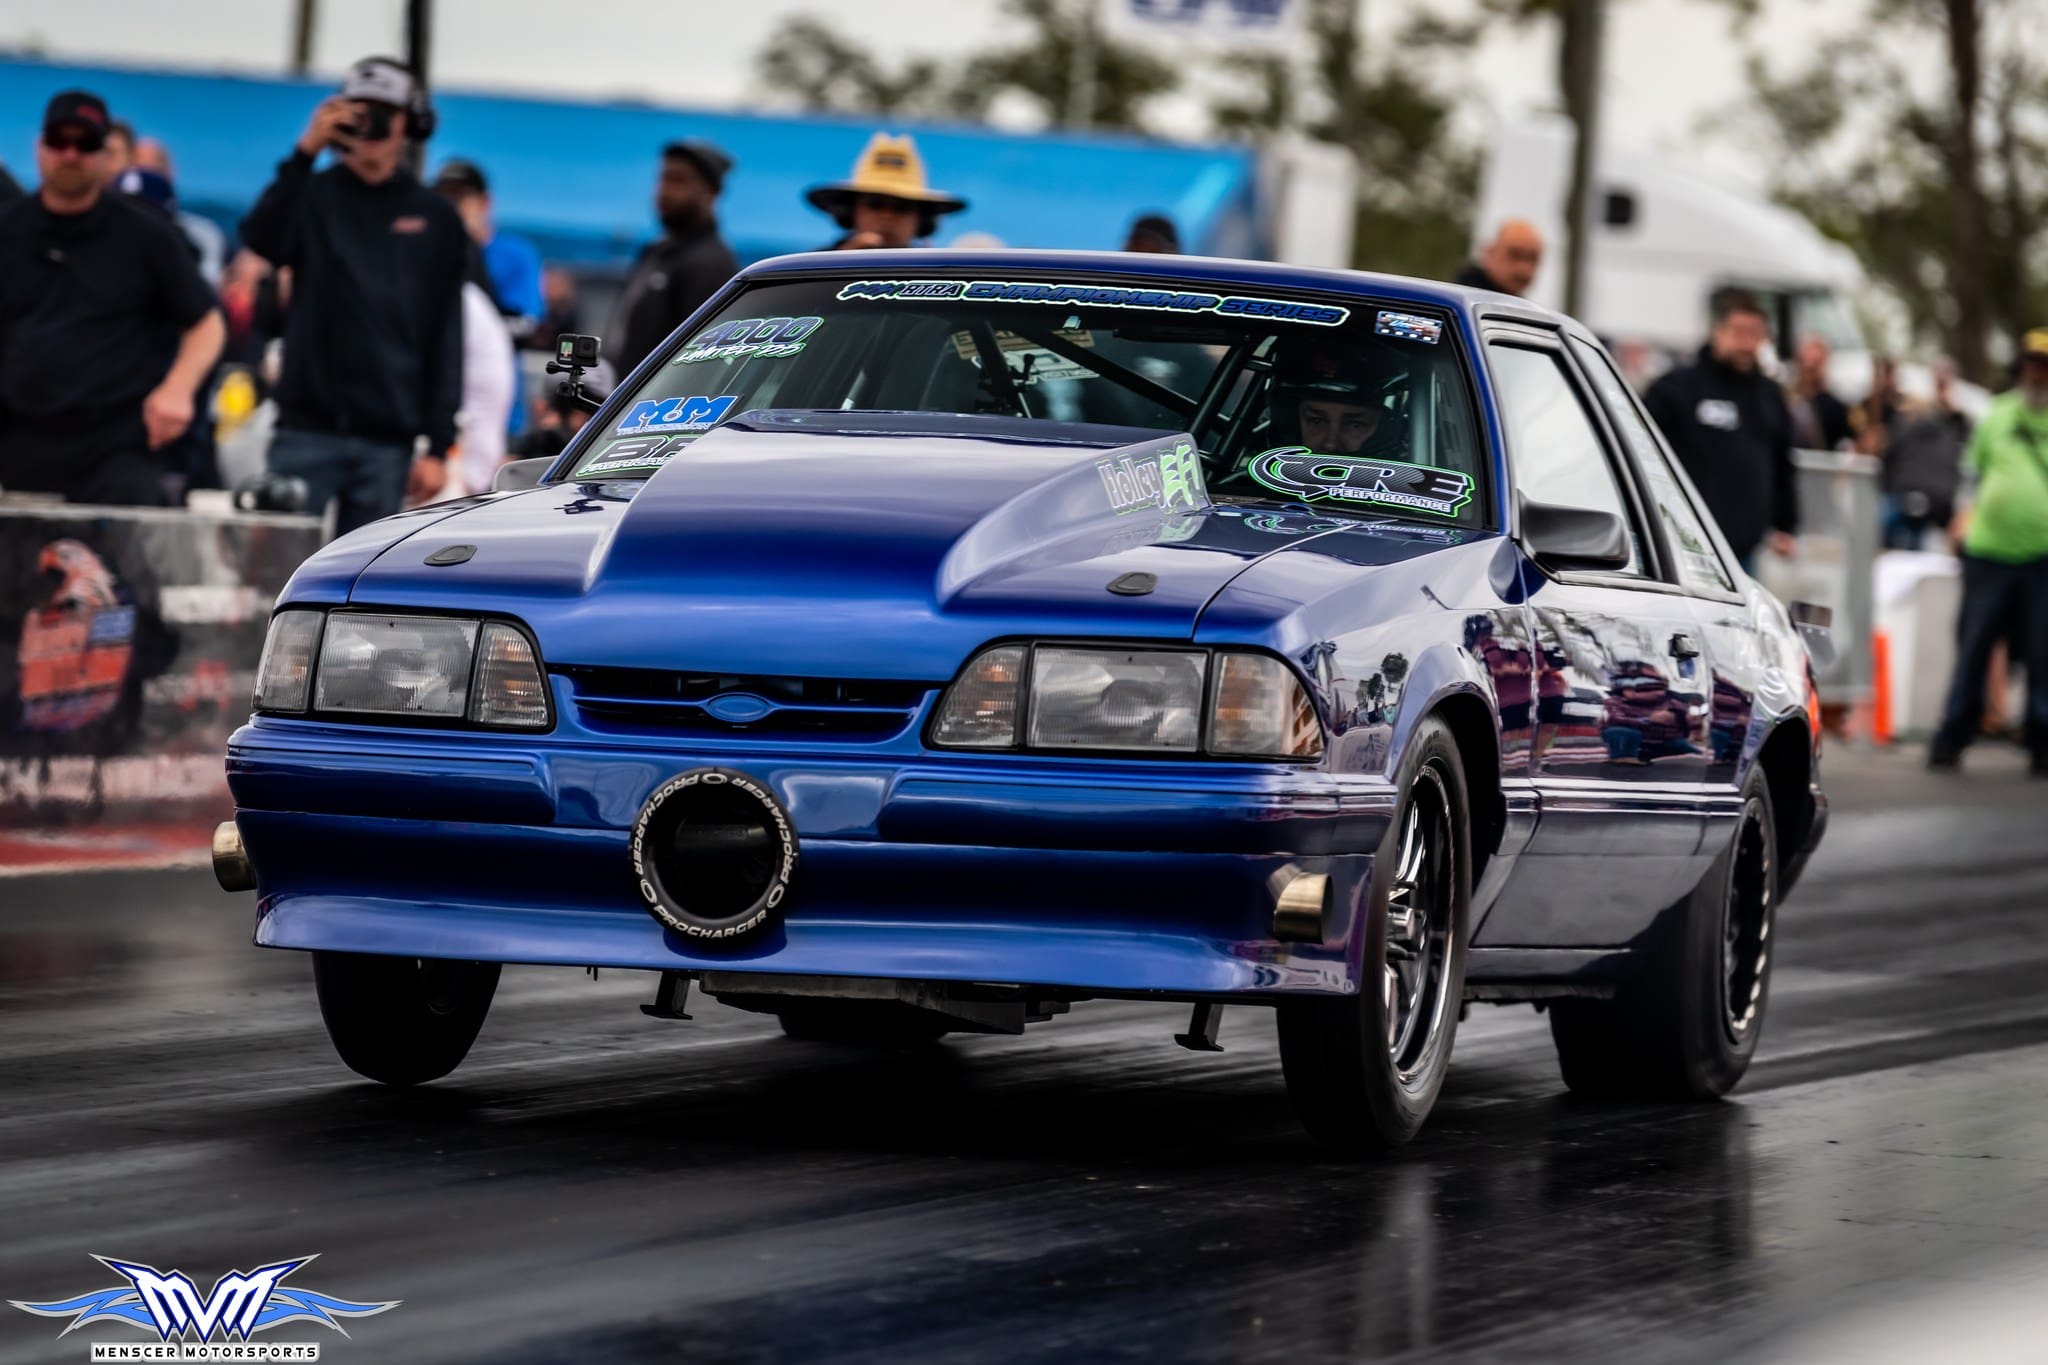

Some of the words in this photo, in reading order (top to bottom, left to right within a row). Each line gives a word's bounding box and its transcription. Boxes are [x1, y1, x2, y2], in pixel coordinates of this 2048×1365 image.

[964, 282, 1219, 311] CHAMPIONSHIP
[1219, 297, 1345, 324] SERIES
[687, 316, 824, 350] 4000
[676, 345, 760, 364] LIMITED
[1160, 444, 1201, 508] EFI
[1328, 487, 1451, 513] PERFORMANCE
[632, 773, 700, 876] PROCHARGER
[731, 777, 794, 885] PROCHARGER
[653, 904, 768, 939] PROCHARGER
